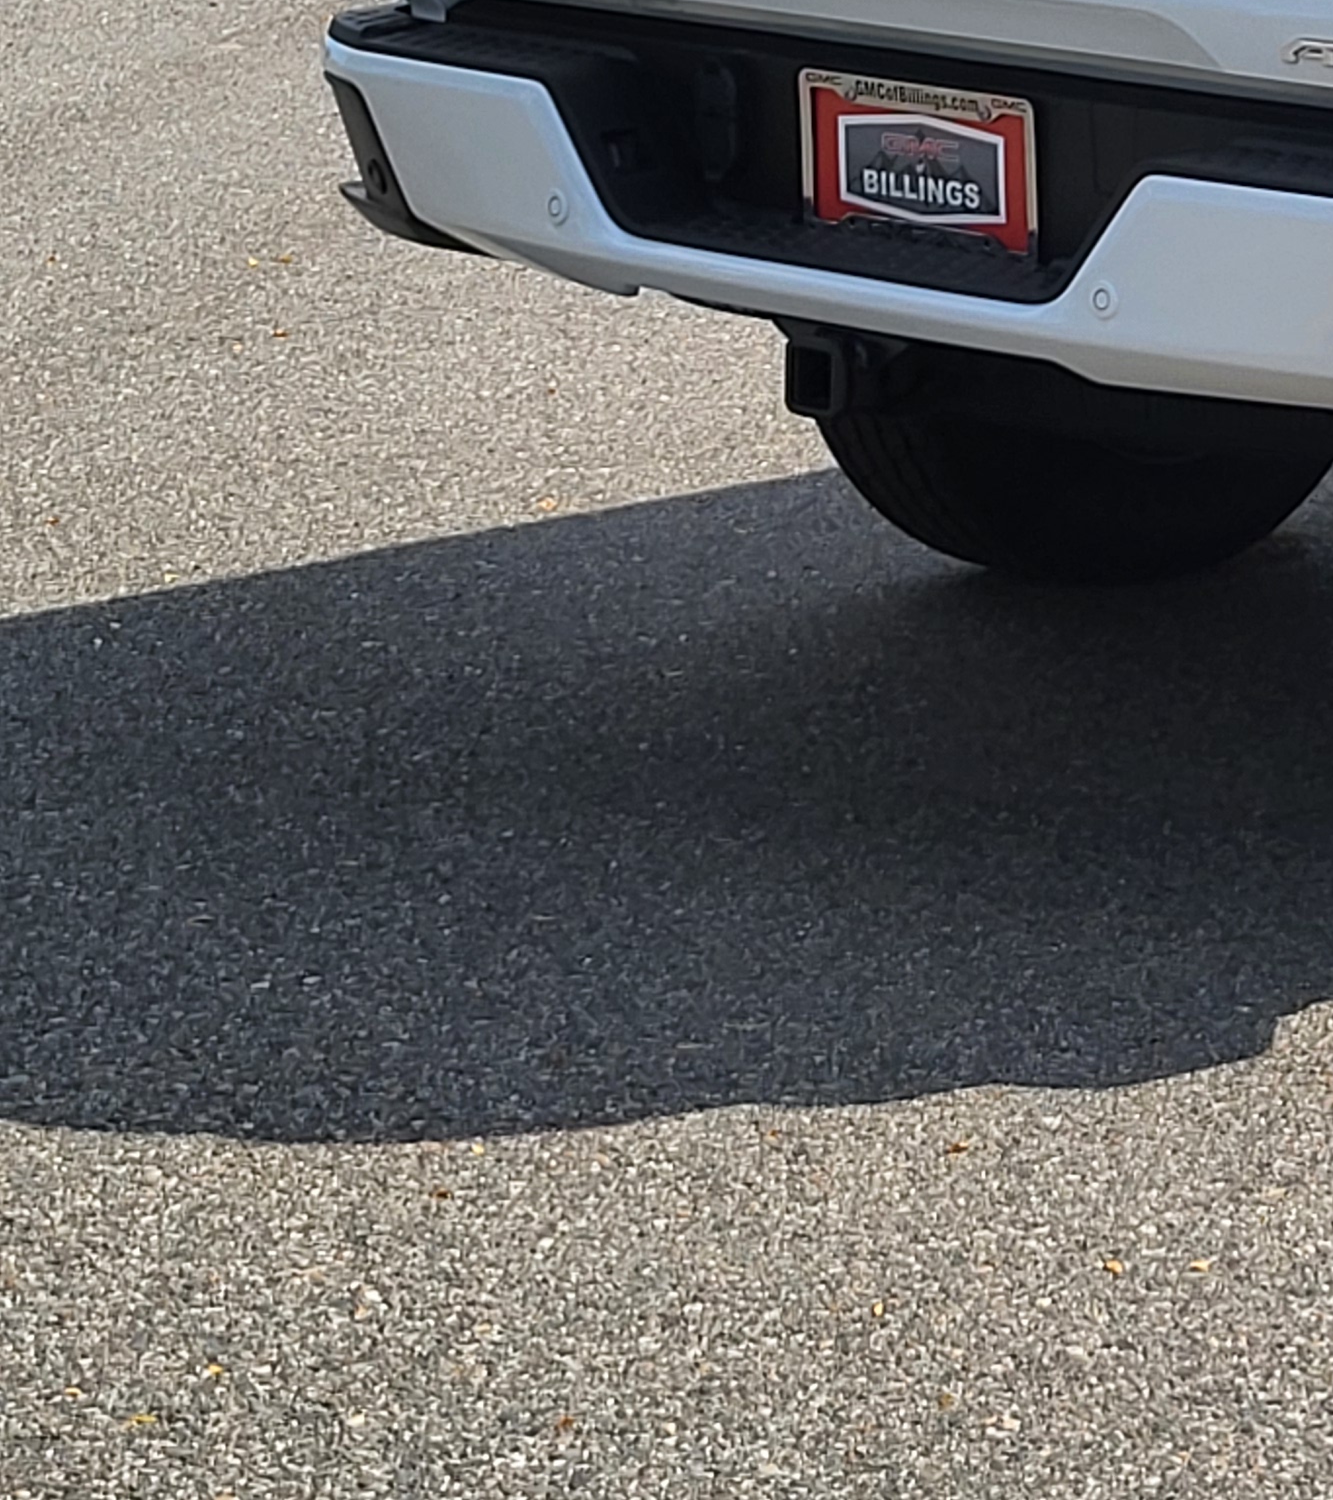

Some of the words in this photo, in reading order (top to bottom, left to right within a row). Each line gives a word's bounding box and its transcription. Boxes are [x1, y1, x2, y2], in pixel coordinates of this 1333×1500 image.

[806, 72, 843, 86] GMC
[854, 78, 980, 114] GMCofBillings.com
[990, 98, 1027, 113] GMC
[881, 132, 959, 162] GMC
[863, 168, 981, 209] BILLINGS
